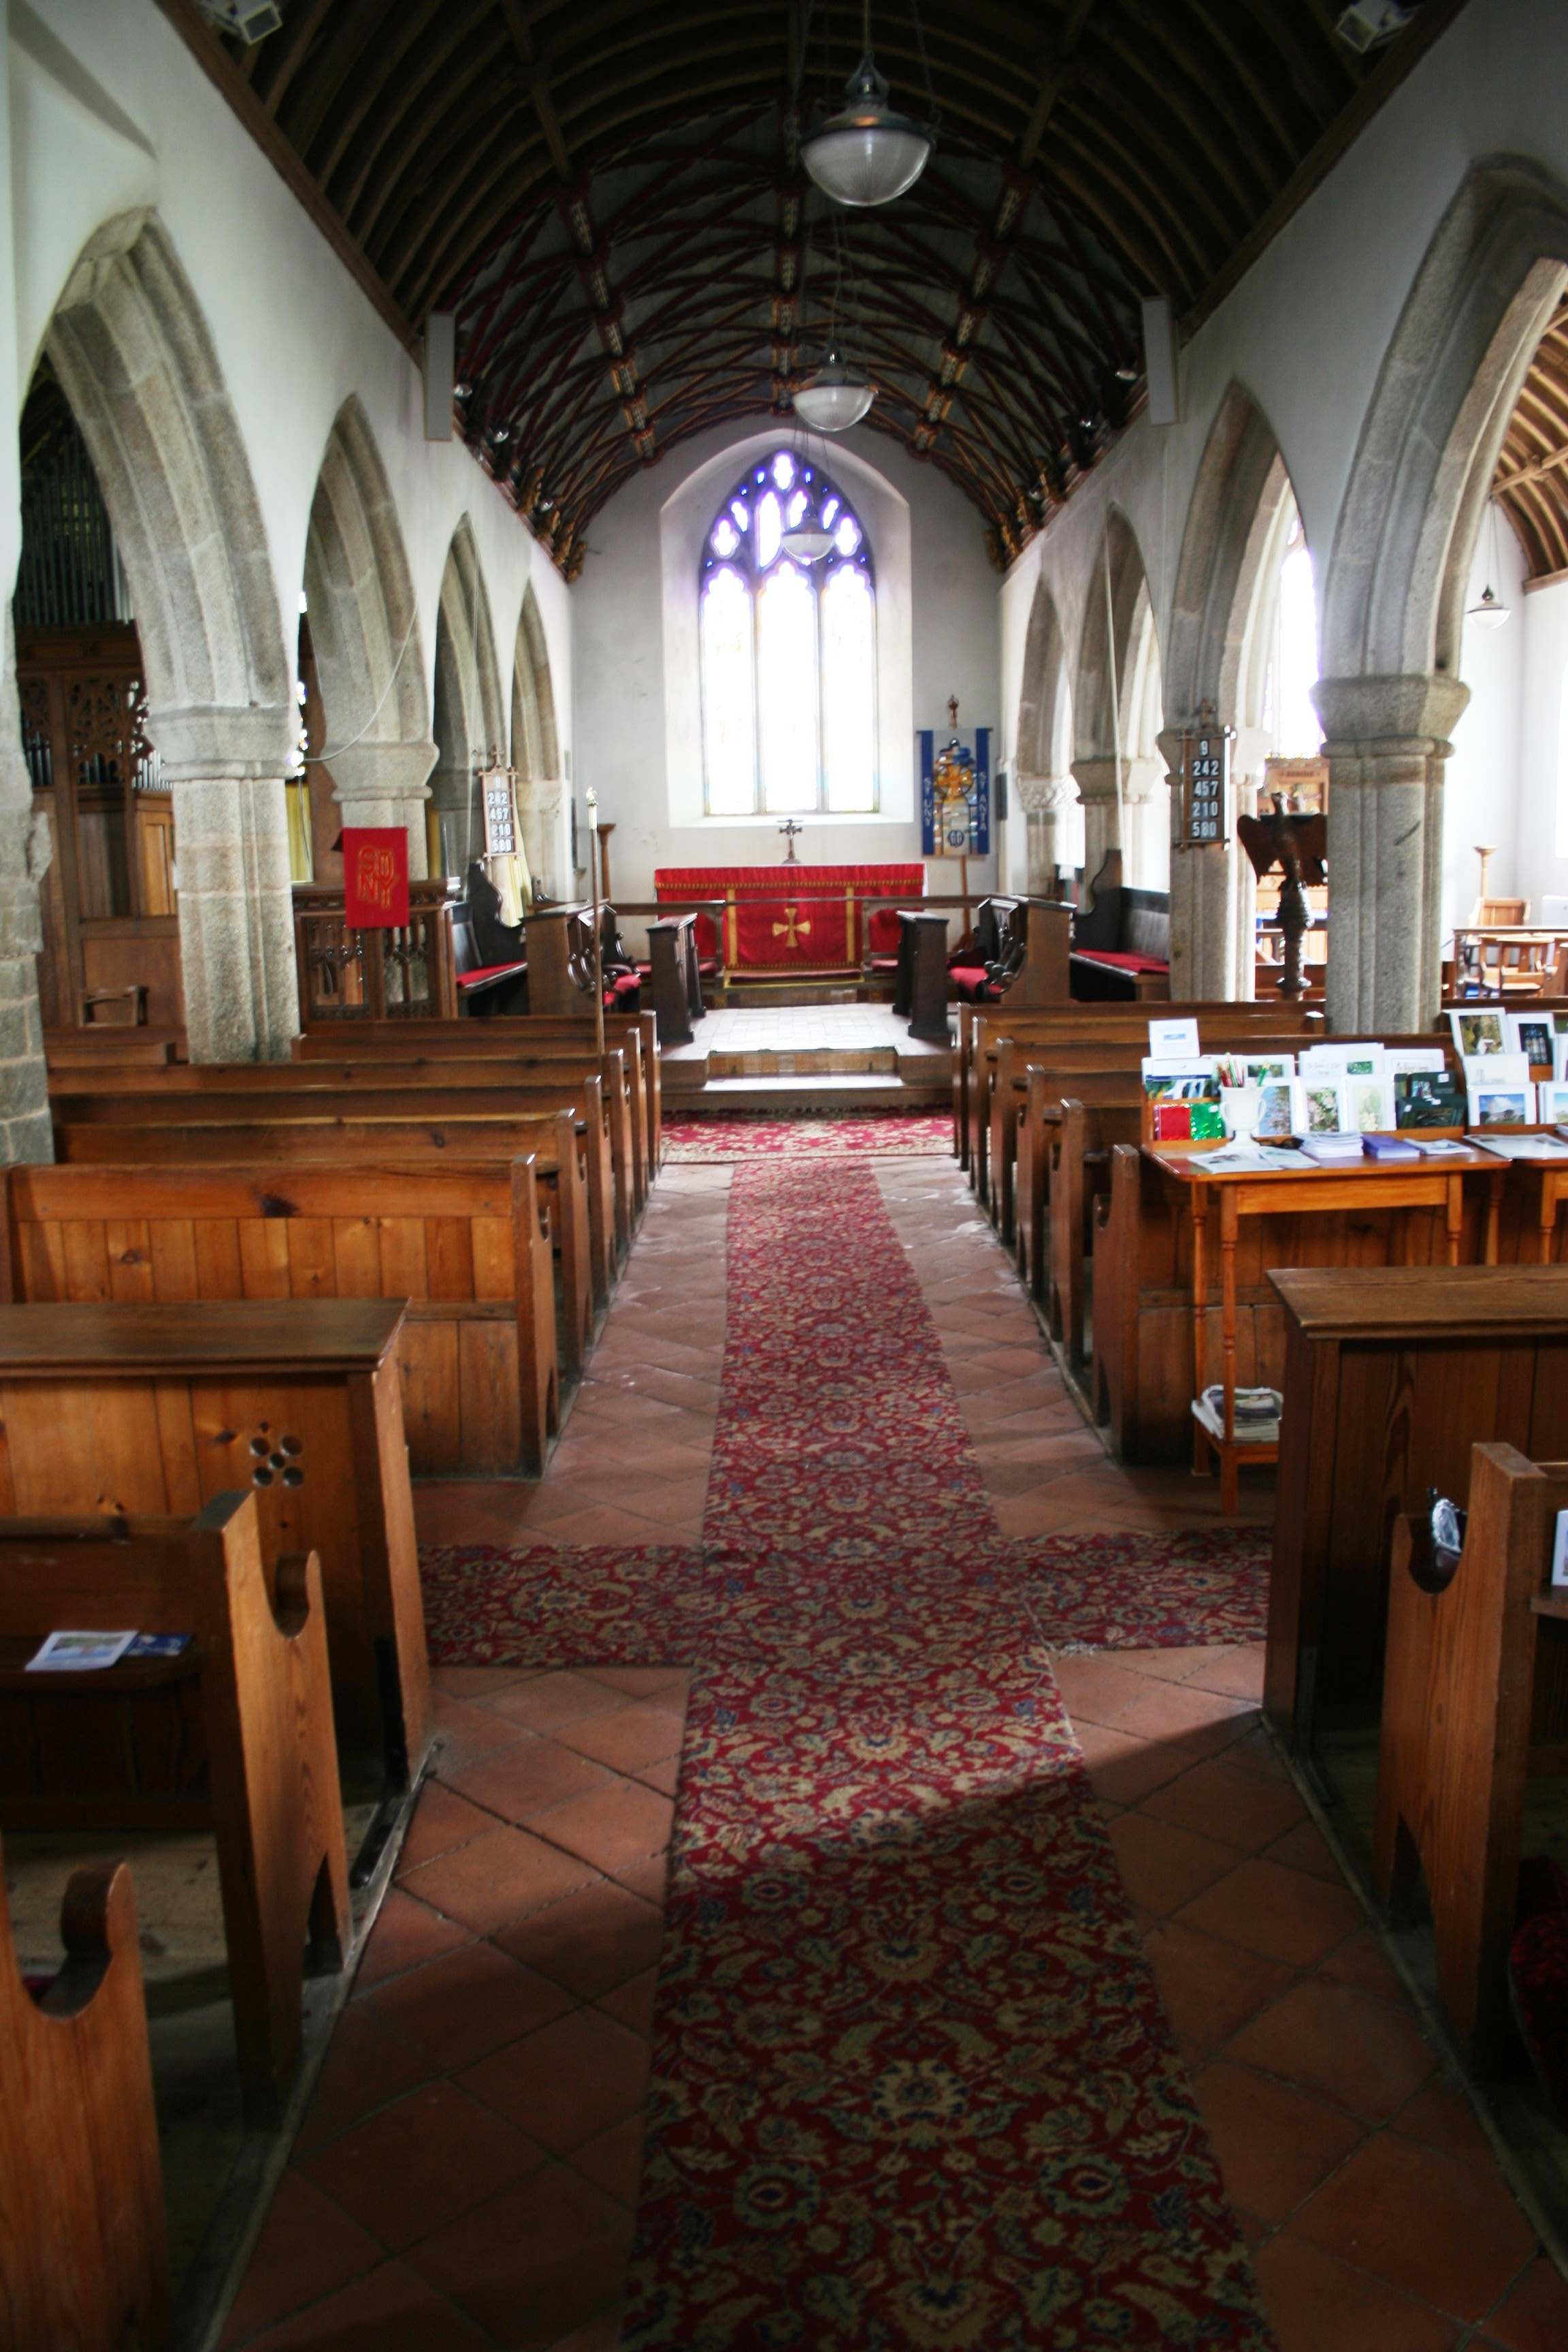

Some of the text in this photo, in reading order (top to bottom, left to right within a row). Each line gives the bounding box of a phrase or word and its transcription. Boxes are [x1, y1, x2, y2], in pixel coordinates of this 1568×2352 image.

[1200, 740, 1208, 756] 9
[1193, 760, 1219, 776] 242
[1194, 781, 1219, 796] 457
[487, 792, 508, 805] 22
[1192, 801, 1218, 817] 210
[1192, 821, 1216, 837] 580
